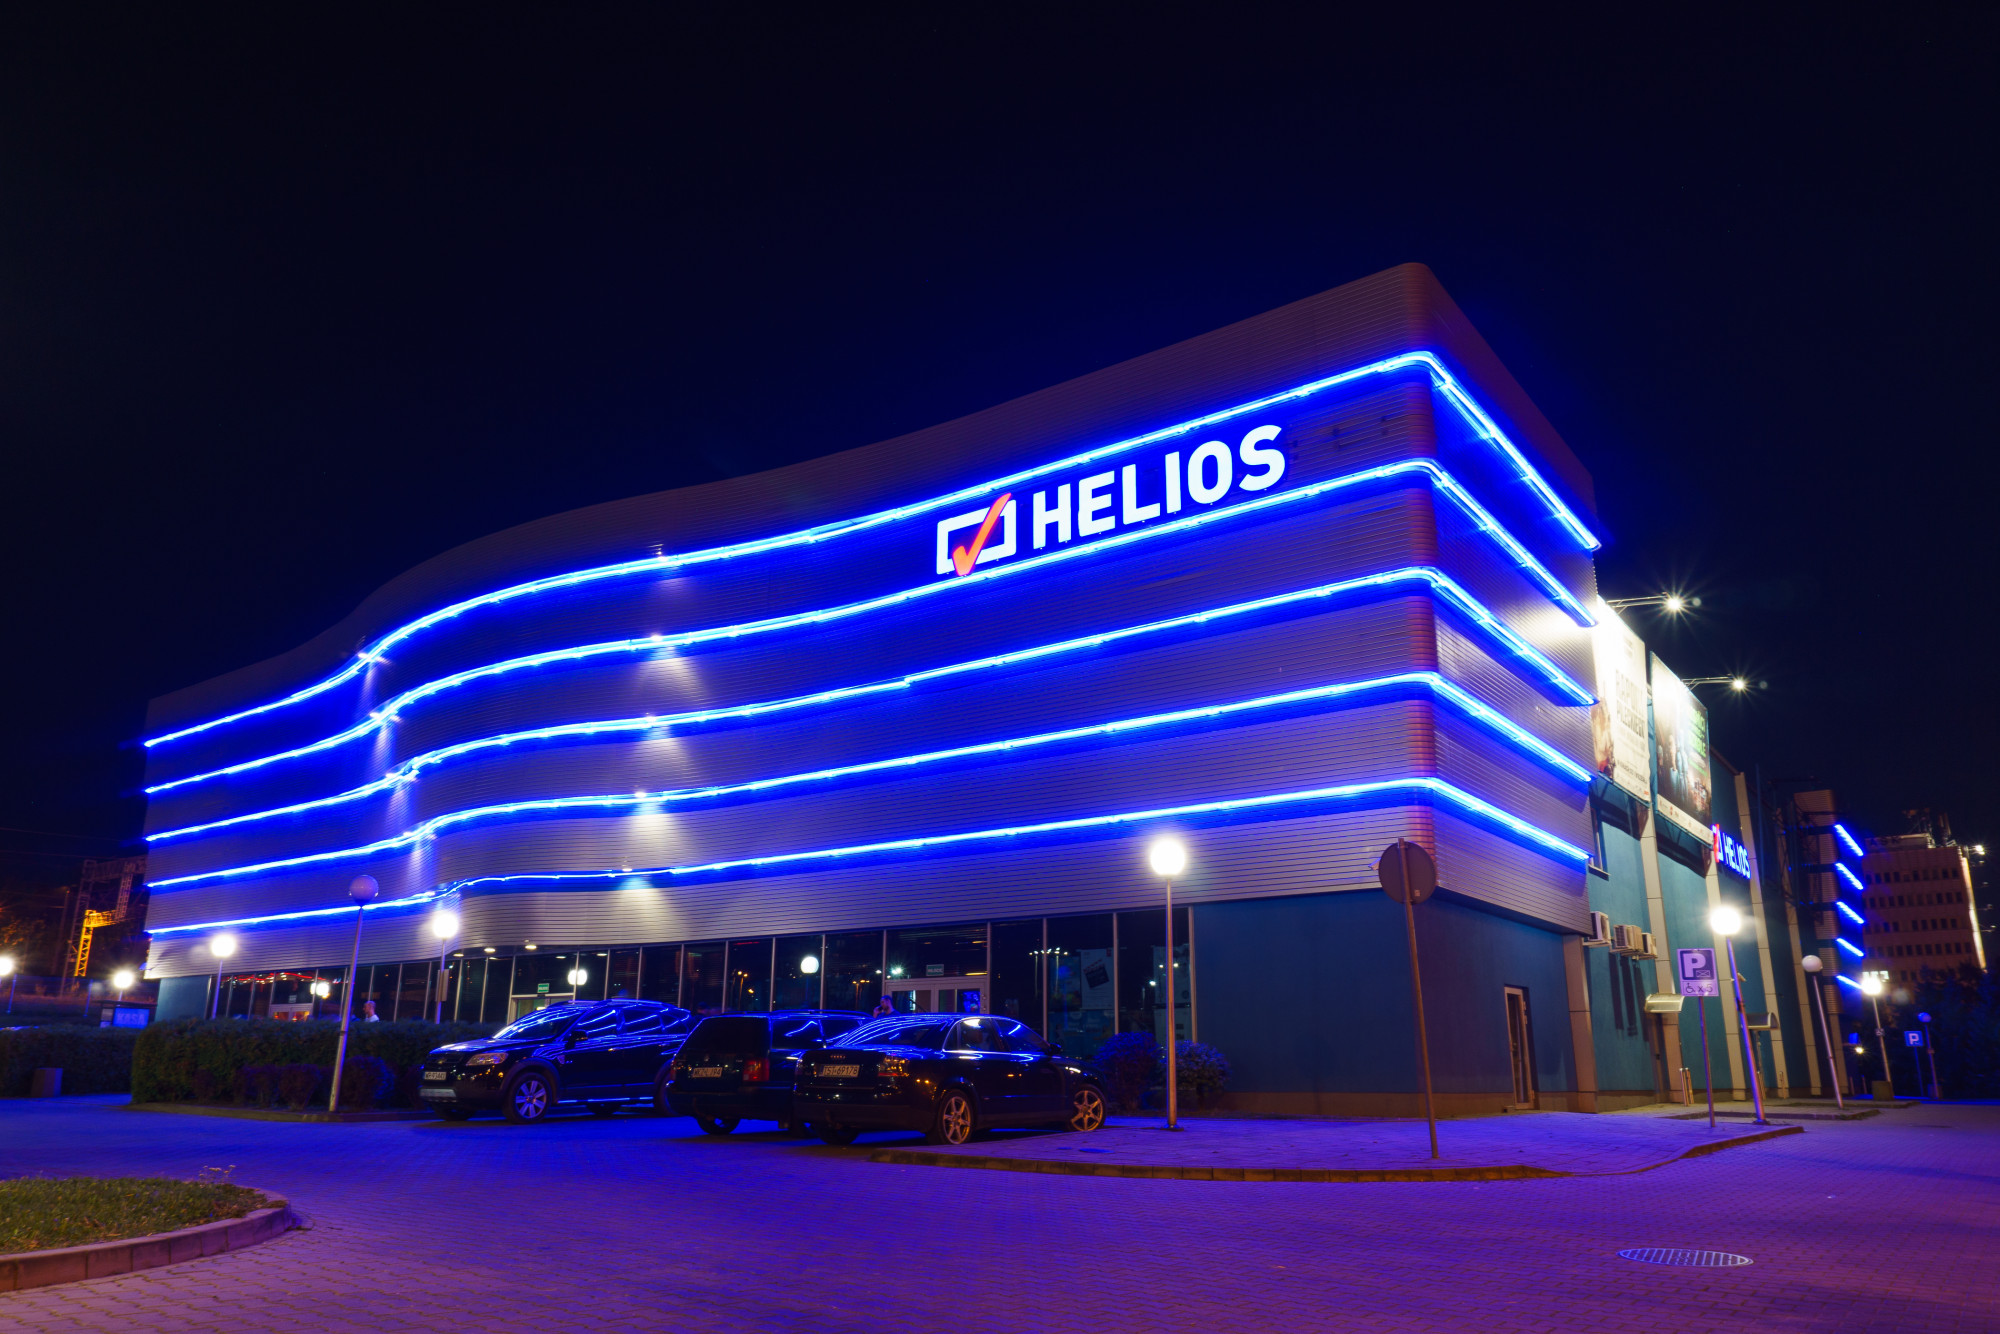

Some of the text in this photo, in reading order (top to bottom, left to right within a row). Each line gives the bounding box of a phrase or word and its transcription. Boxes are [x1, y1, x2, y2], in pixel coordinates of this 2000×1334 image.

[1033, 424, 1286, 549] HELIOS
[1722, 832, 1751, 879] HELIOS
[1683, 953, 1706, 977] P
[1706, 984, 1713, 992] 5
[1908, 1033, 1920, 1045] P
